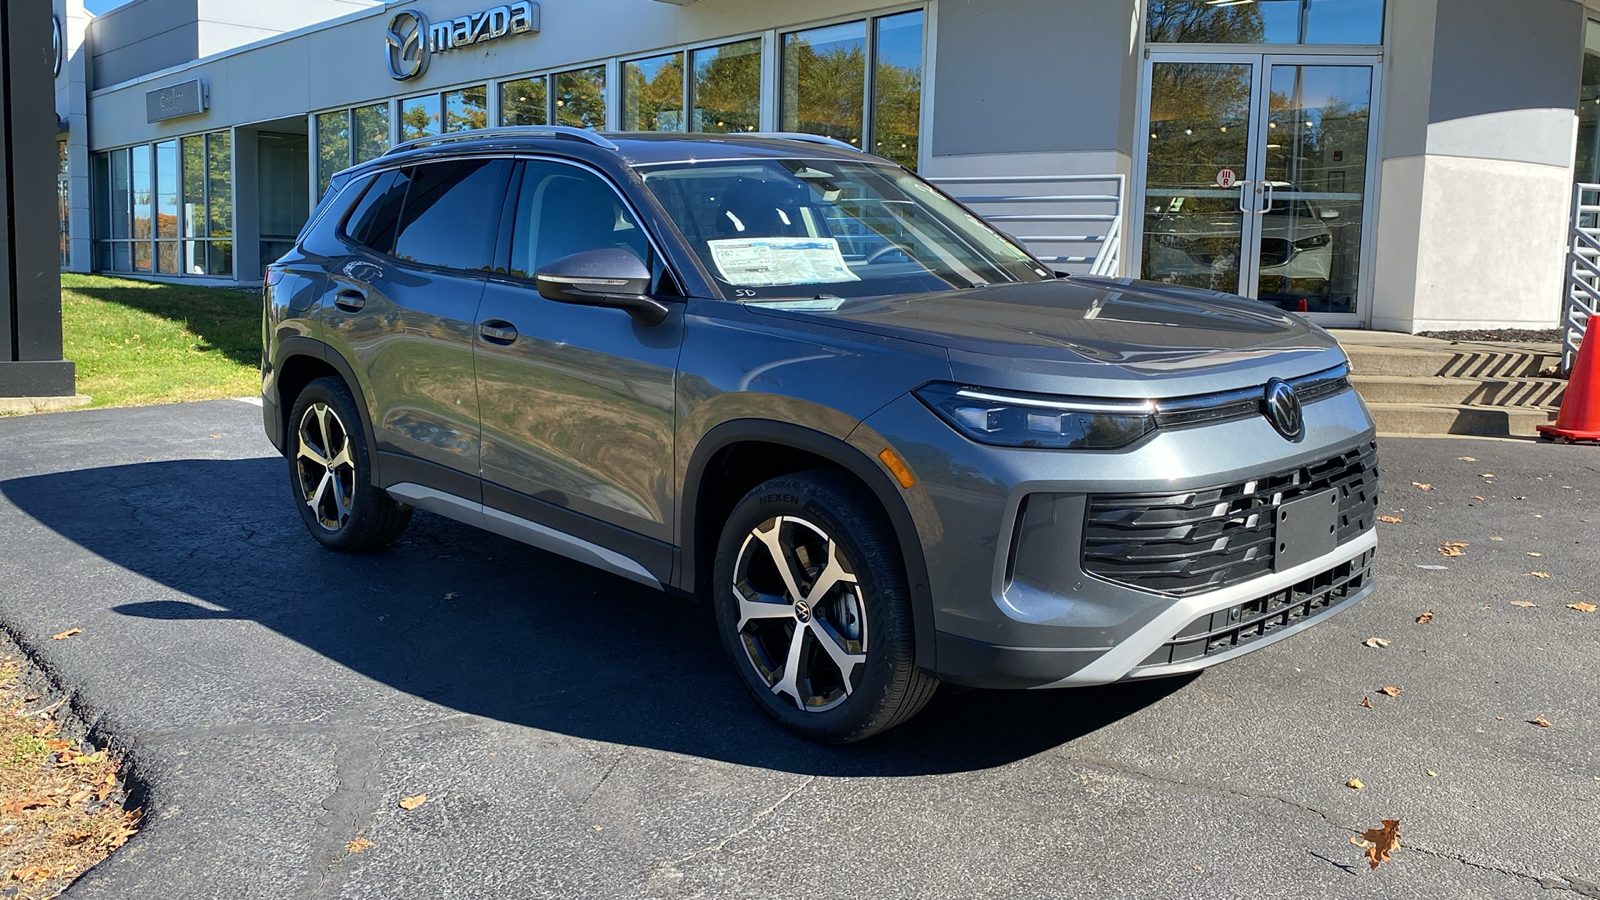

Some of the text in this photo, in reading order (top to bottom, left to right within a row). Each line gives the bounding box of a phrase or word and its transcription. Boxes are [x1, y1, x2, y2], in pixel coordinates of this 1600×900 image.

[429, 0, 538, 54] mazda
[1223, 178, 1229, 186] R
[735, 289, 756, 297] SD
[759, 493, 799, 505] NEXEN
